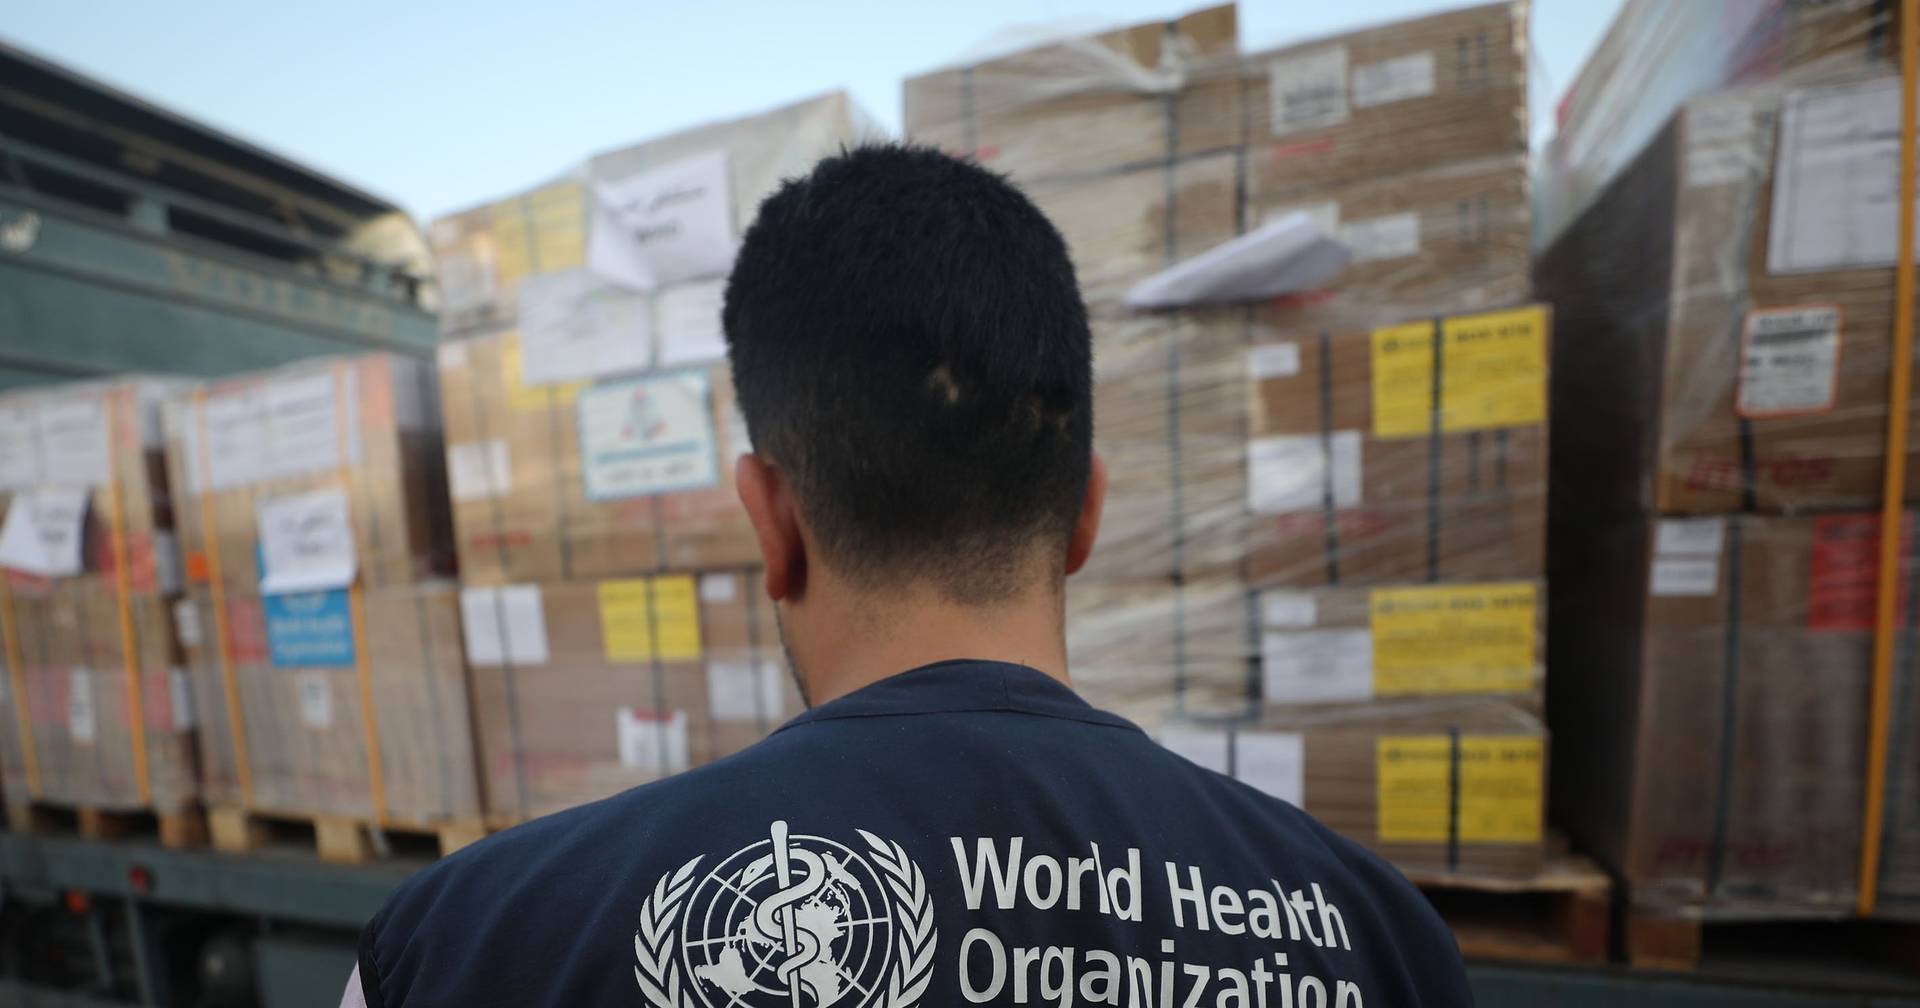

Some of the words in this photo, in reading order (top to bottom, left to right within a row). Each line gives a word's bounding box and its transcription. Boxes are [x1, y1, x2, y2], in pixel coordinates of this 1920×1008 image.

[950, 836, 1142, 922] World
[1165, 861, 1351, 951] Health
[959, 928, 1363, 1008] Organization
